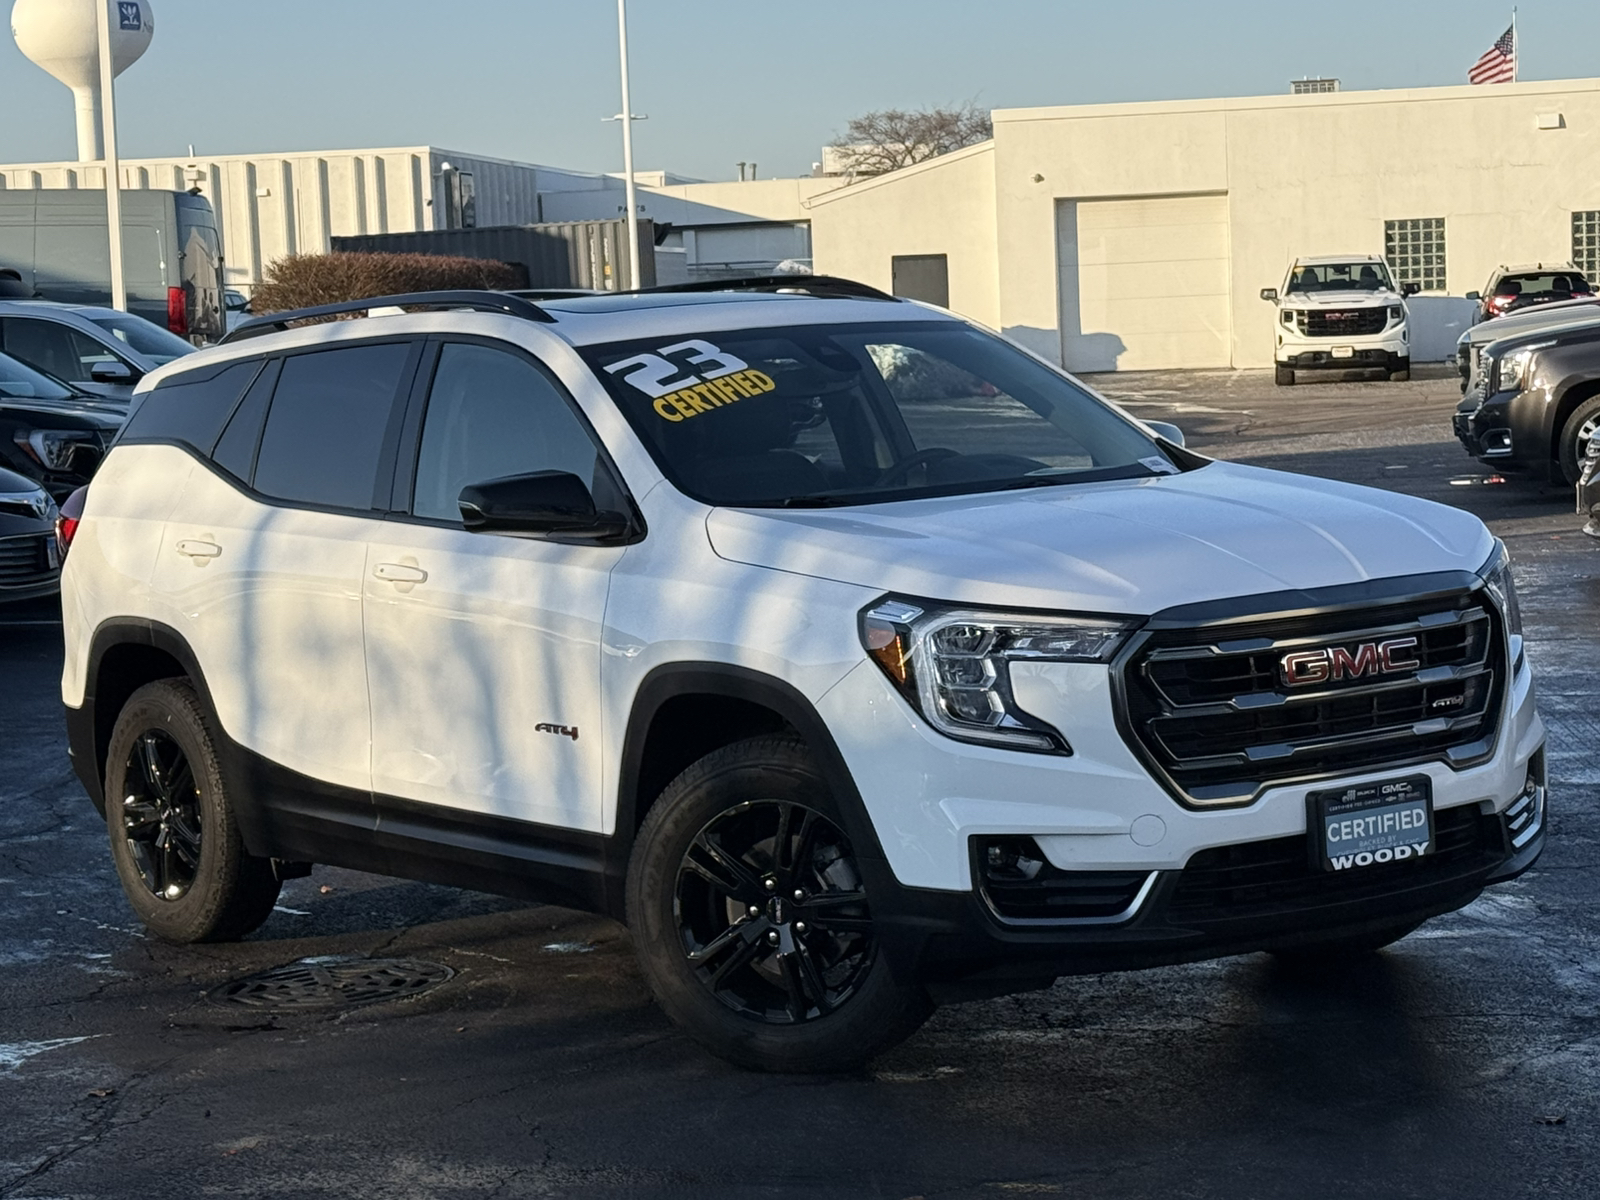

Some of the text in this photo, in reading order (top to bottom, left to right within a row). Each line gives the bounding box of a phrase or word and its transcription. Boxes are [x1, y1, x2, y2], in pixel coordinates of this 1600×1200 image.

[617, 204, 646, 213] PAS
[602, 339, 748, 398] 23
[653, 370, 776, 422] CERTIFIED
[1281, 636, 1420, 687] GMC
[535, 722, 579, 741] AT4
[1381, 782, 1408, 794] GMC
[1327, 808, 1426, 842] CERTIFIED
[1387, 835, 1397, 843] BY
[1330, 841, 1430, 871] WOODY
